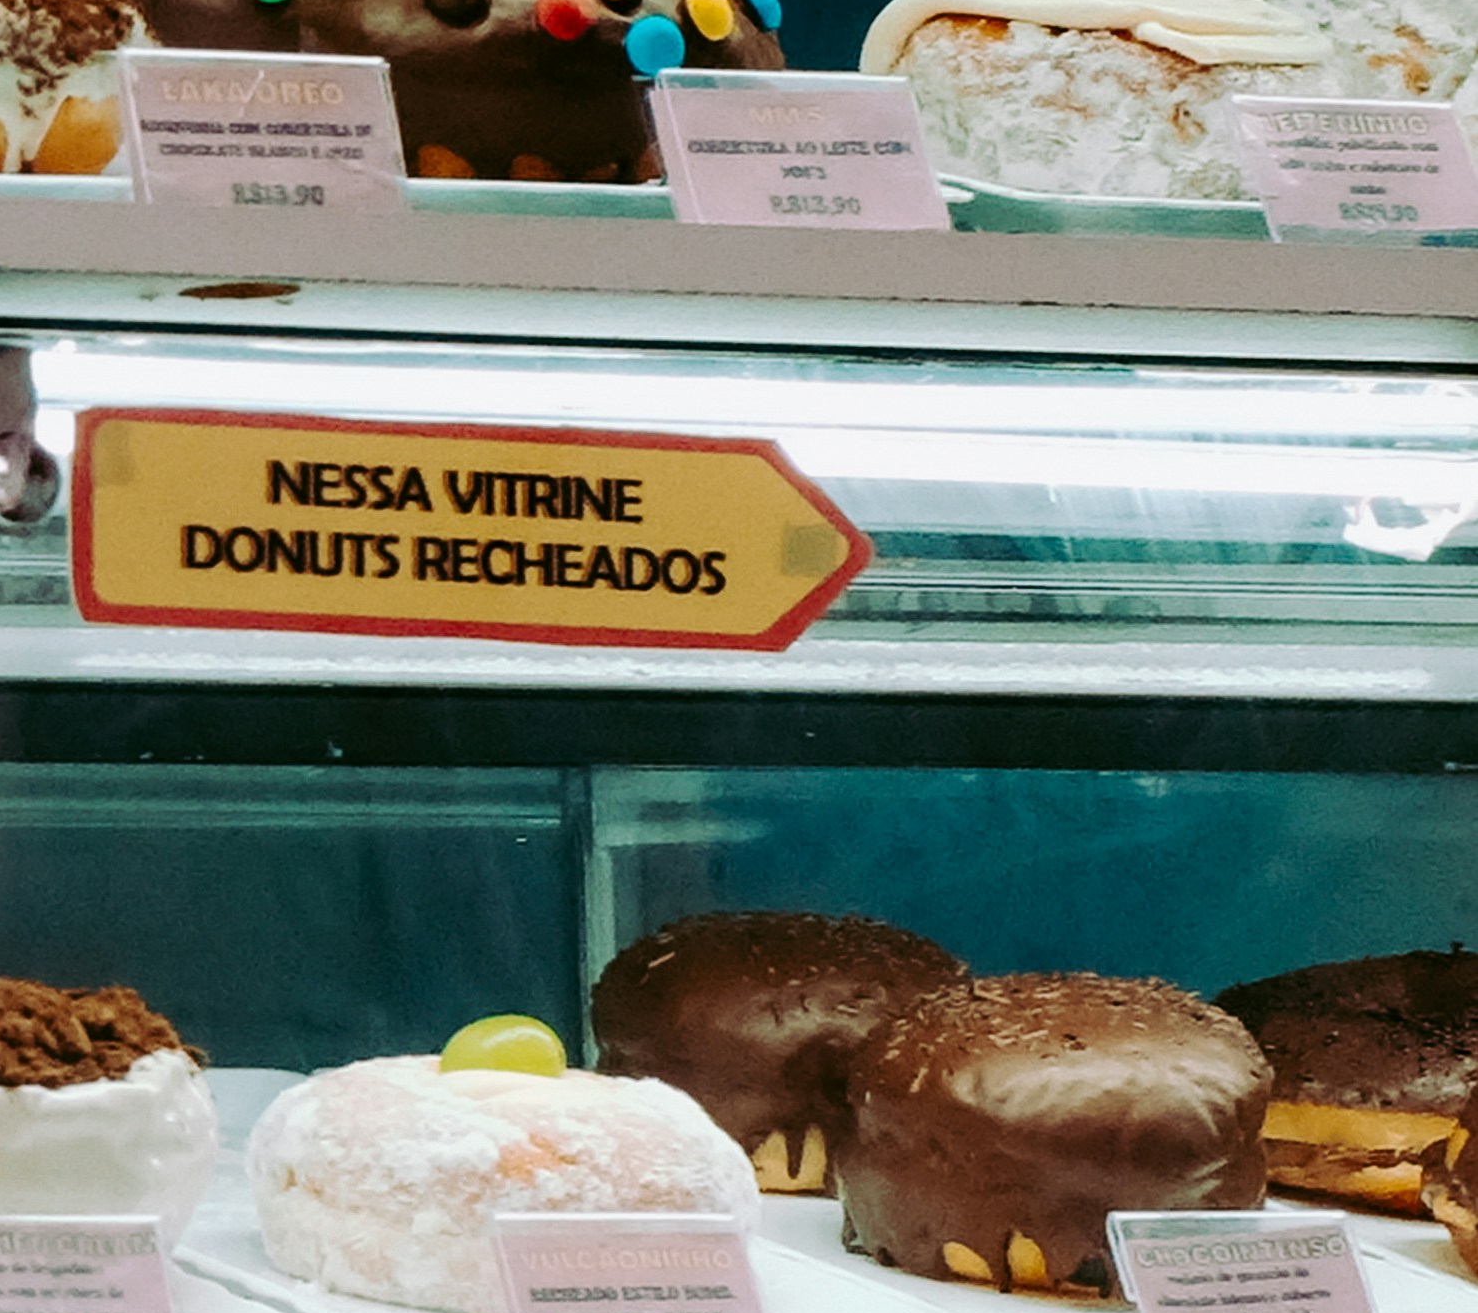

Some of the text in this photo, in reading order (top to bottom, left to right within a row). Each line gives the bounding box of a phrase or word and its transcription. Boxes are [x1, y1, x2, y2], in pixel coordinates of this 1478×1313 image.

[266, 459, 645, 524] NESSA VITRINE
[180, 524, 728, 596] DONUTS RECHEADOS
